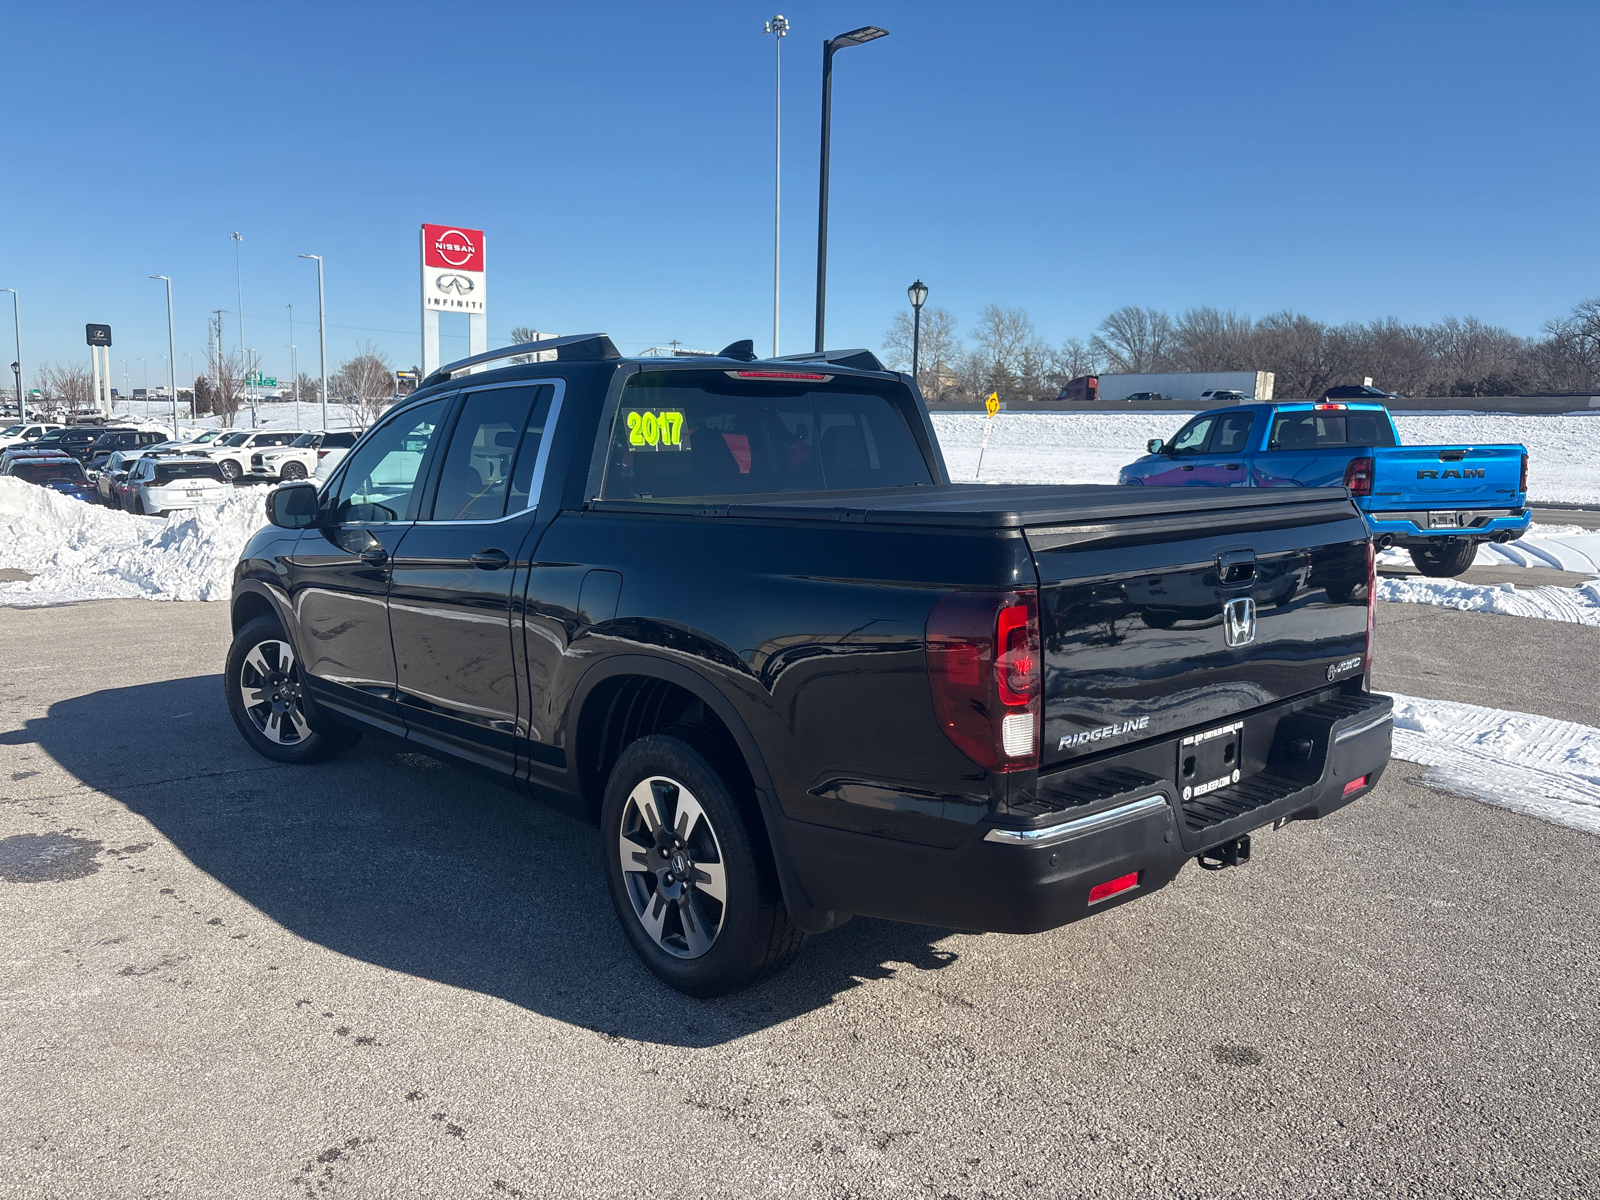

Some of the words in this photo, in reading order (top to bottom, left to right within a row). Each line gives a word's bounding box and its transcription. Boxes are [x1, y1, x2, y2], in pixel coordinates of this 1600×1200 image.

[435, 242, 475, 254] NISSAN
[428, 297, 482, 310] INFINITI
[627, 411, 684, 446] 2017
[1416, 468, 1485, 480] RAM
[1058, 716, 1150, 752] RIDGELINE
